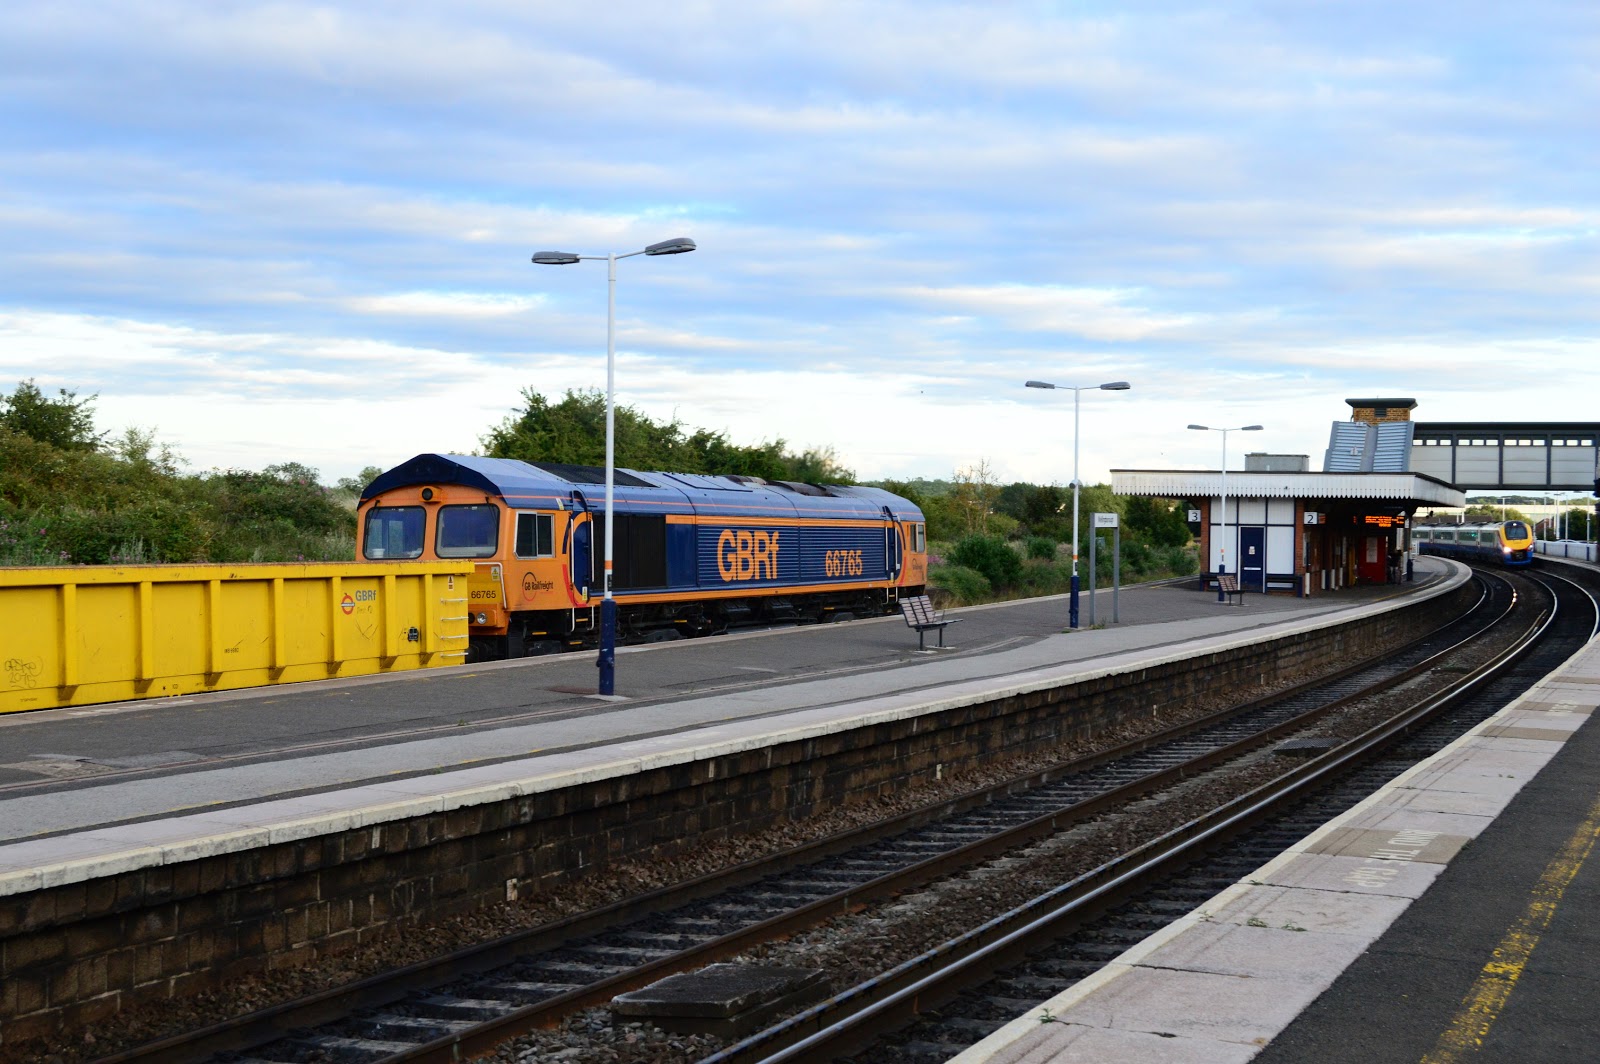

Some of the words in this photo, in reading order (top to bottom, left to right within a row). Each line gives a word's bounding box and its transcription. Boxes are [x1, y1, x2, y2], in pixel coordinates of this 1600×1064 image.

[1191, 511, 1198, 522] 3
[1307, 514, 1314, 524] 2
[717, 529, 779, 582] GBRf
[825, 550, 862, 577] 66765
[524, 581, 531, 591] GB
[531, 580, 554, 592] Railfreight
[355, 589, 377, 601] GBRf
[470, 590, 497, 599] 66765
